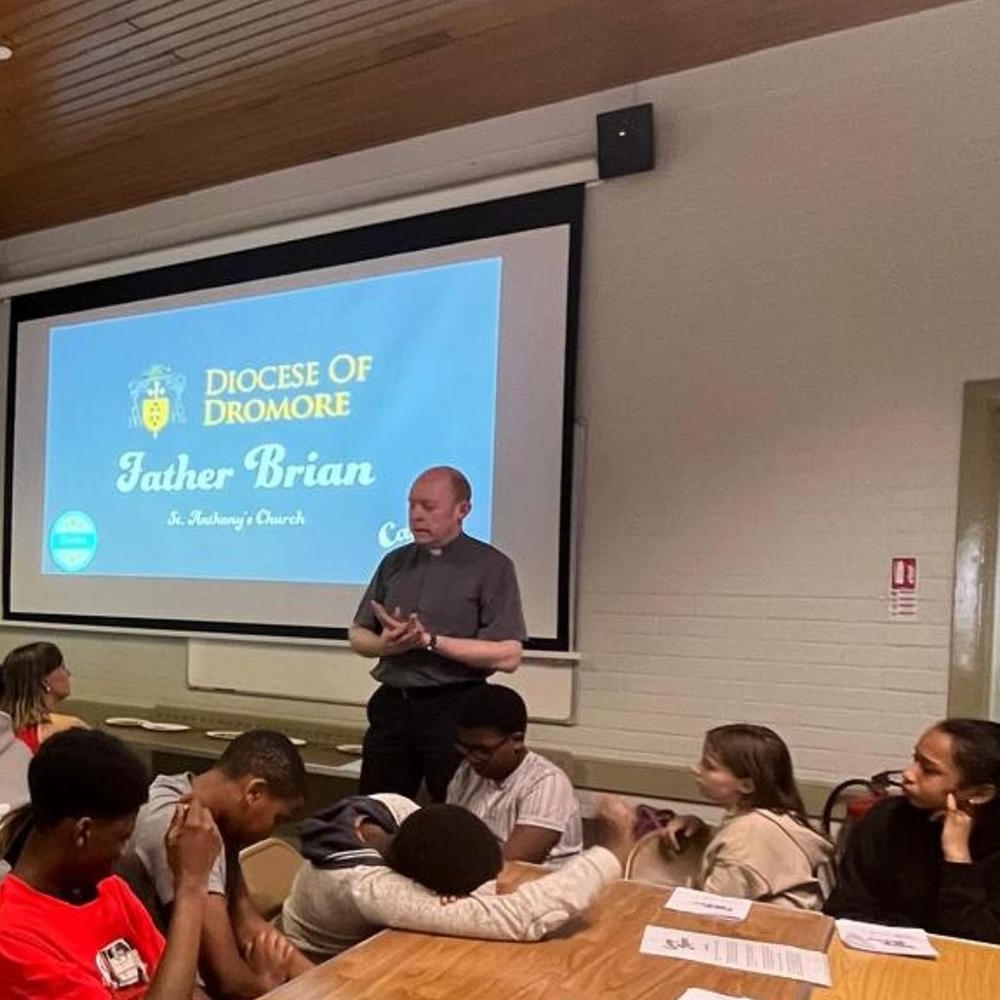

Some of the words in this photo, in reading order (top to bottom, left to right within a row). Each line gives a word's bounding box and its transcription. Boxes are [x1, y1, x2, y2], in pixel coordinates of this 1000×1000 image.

[204, 361, 320, 396] DIOCESE
[328, 353, 373, 384] OF
[203, 391, 351, 426] DROMORE
[116, 451, 234, 493] Father
[244, 443, 375, 489] Brian
[255, 508, 305, 525] Church
